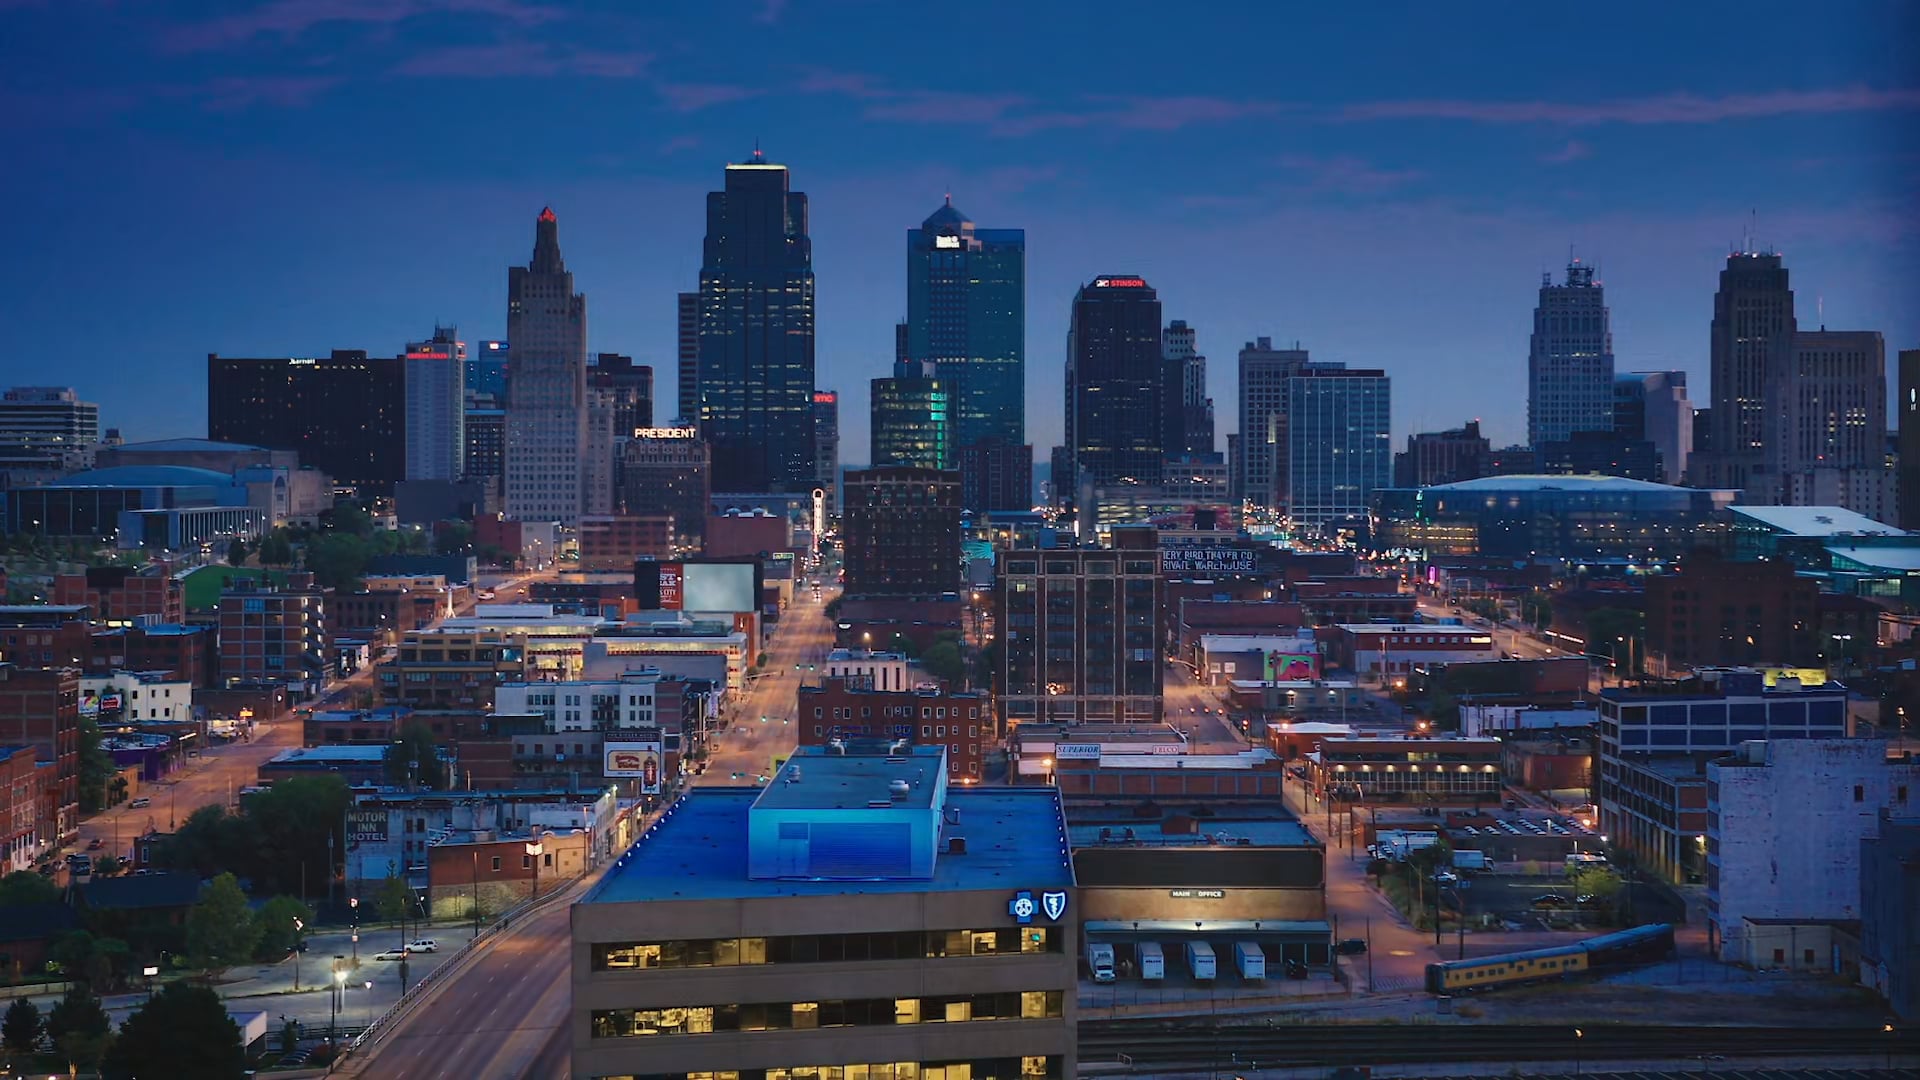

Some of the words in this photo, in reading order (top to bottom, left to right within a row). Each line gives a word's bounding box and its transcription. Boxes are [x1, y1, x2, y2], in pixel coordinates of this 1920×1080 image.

[1110, 279, 1143, 287] STINSON
[634, 428, 696, 438] PRESIDENT
[1194, 560, 1252, 570] WAREHOUSE
[1057, 745, 1099, 753] SUPERIOR
[347, 811, 386, 822] MOTOR
[357, 822, 377, 832] INN
[347, 832, 387, 841] HOTEL
[1198, 890, 1222, 898] OFFICE
